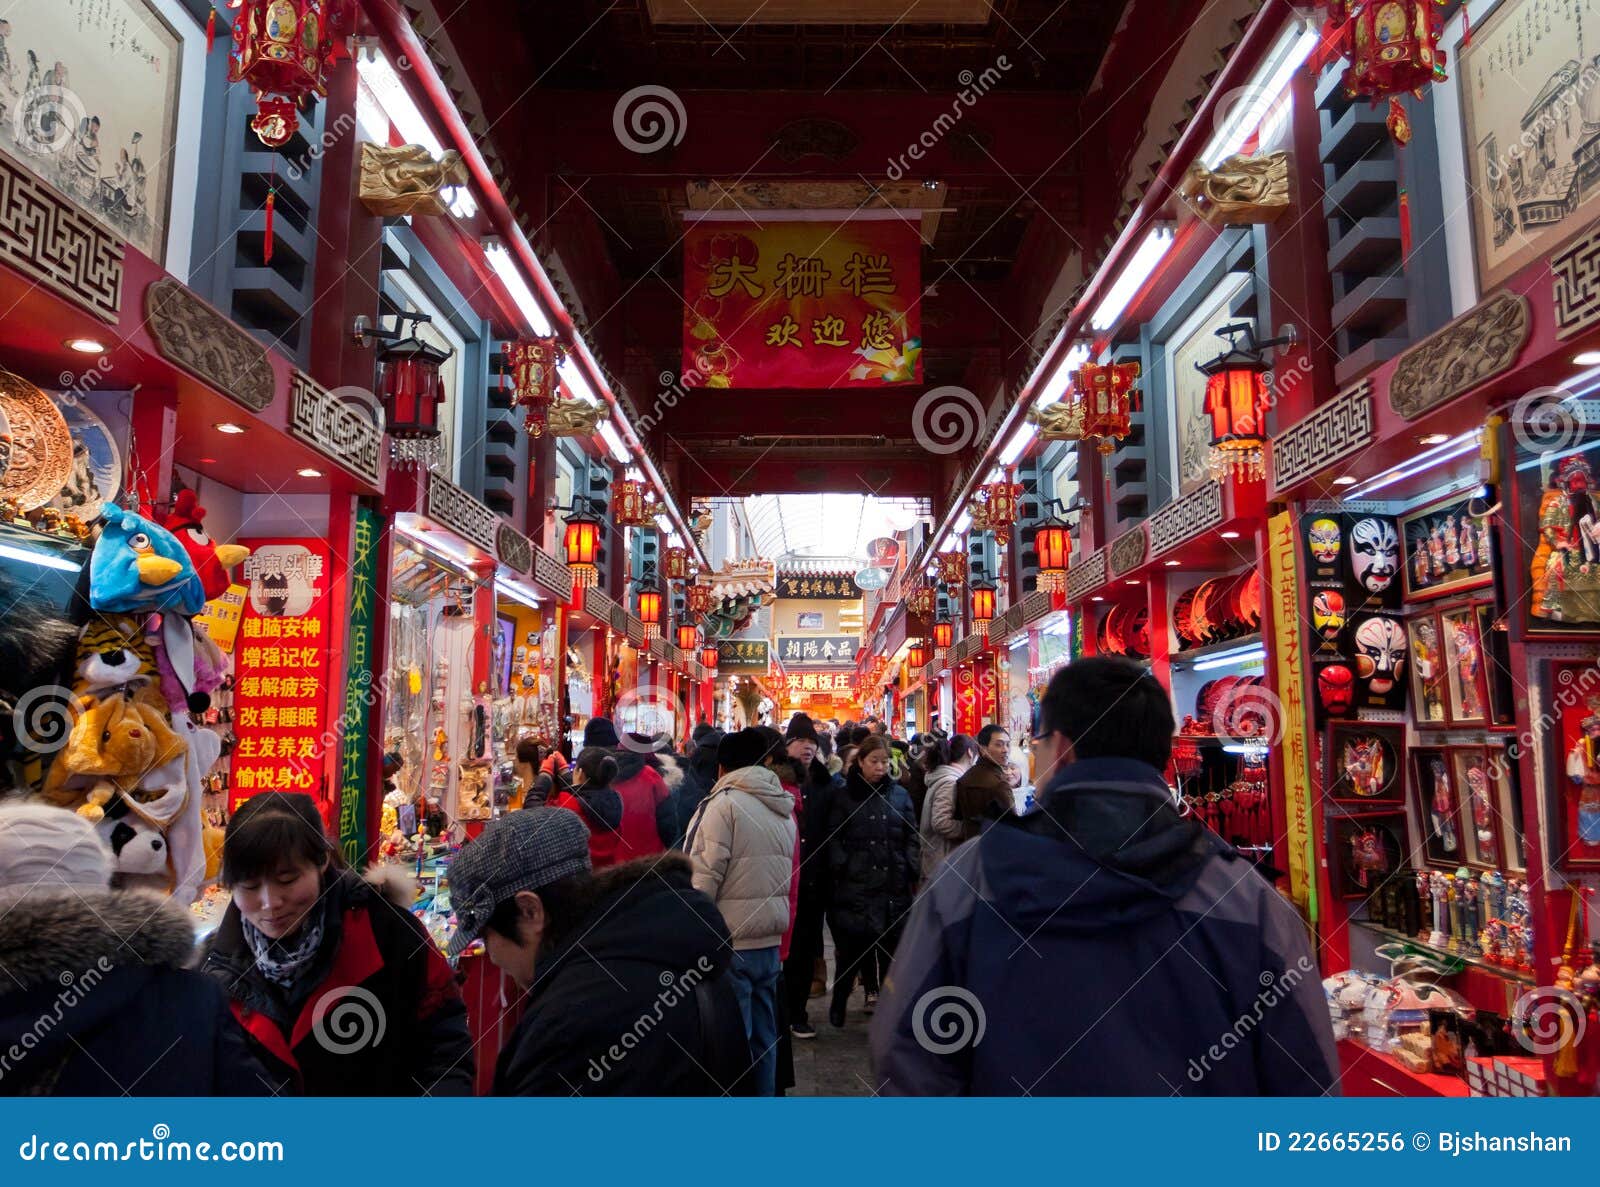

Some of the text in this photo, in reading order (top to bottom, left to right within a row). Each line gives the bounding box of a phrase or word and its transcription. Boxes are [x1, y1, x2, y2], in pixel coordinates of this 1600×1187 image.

[708, 253, 897, 299] 大栅栏
[765, 312, 895, 350] 欢迎您
[242, 617, 321, 638] 健脑安神
[241, 647, 320, 669] 增强记忆
[786, 640, 852, 657] 朝陽食品
[240, 677, 319, 698] 缓解疲劳
[787, 673, 850, 690] 来顺饭庄
[239, 707, 318, 728] 改善睡眠
[238, 737, 316, 758] 生发养发
[236, 766, 314, 788] 愉悦身心
